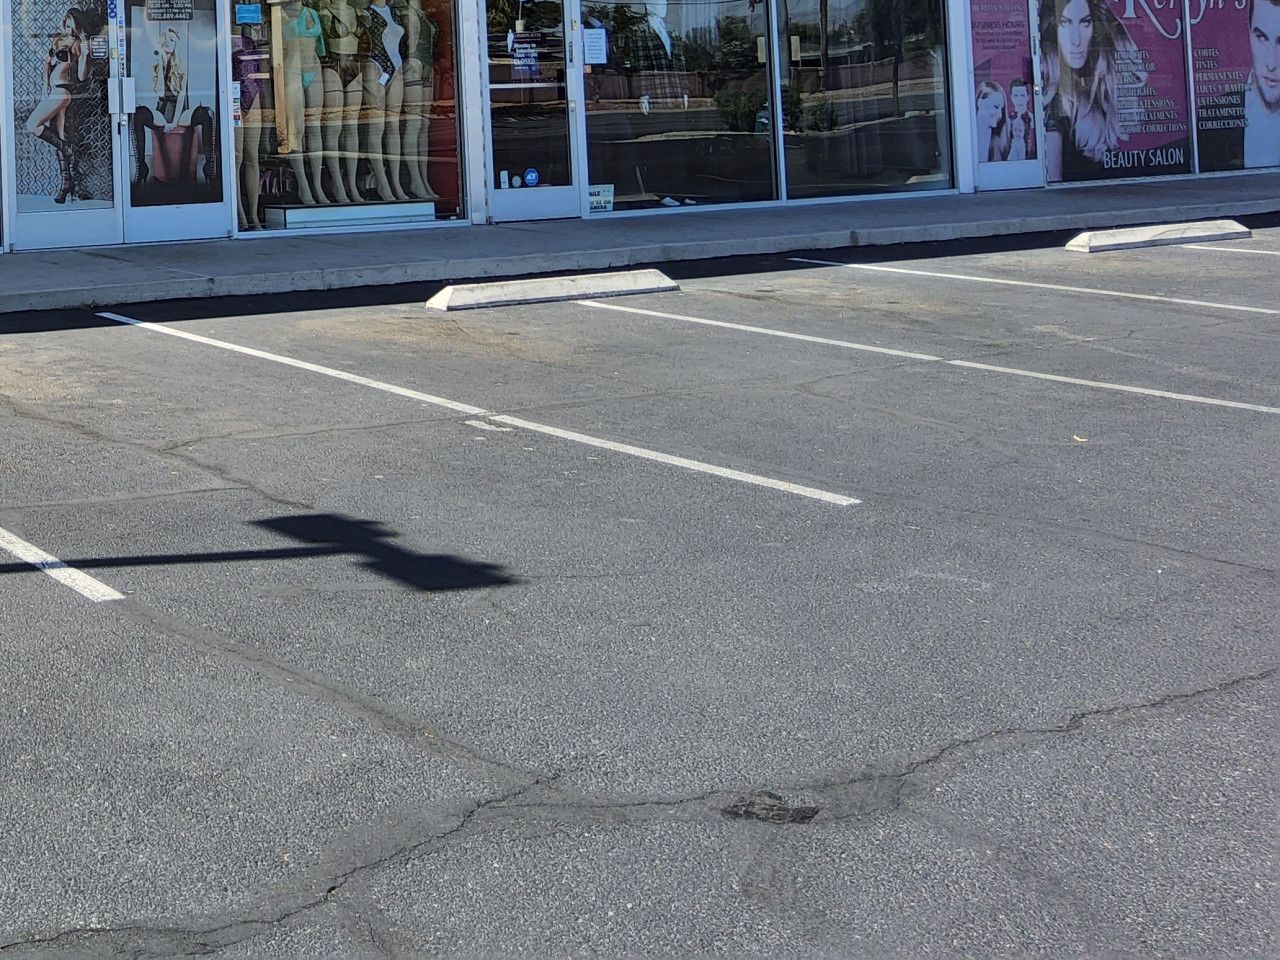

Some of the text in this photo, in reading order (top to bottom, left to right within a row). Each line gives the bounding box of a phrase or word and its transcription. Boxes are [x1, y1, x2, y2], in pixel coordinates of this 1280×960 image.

[1197, 95, 1241, 106] EXTENSIONES
[1103, 148, 1184, 169] BEAUTY SALON
